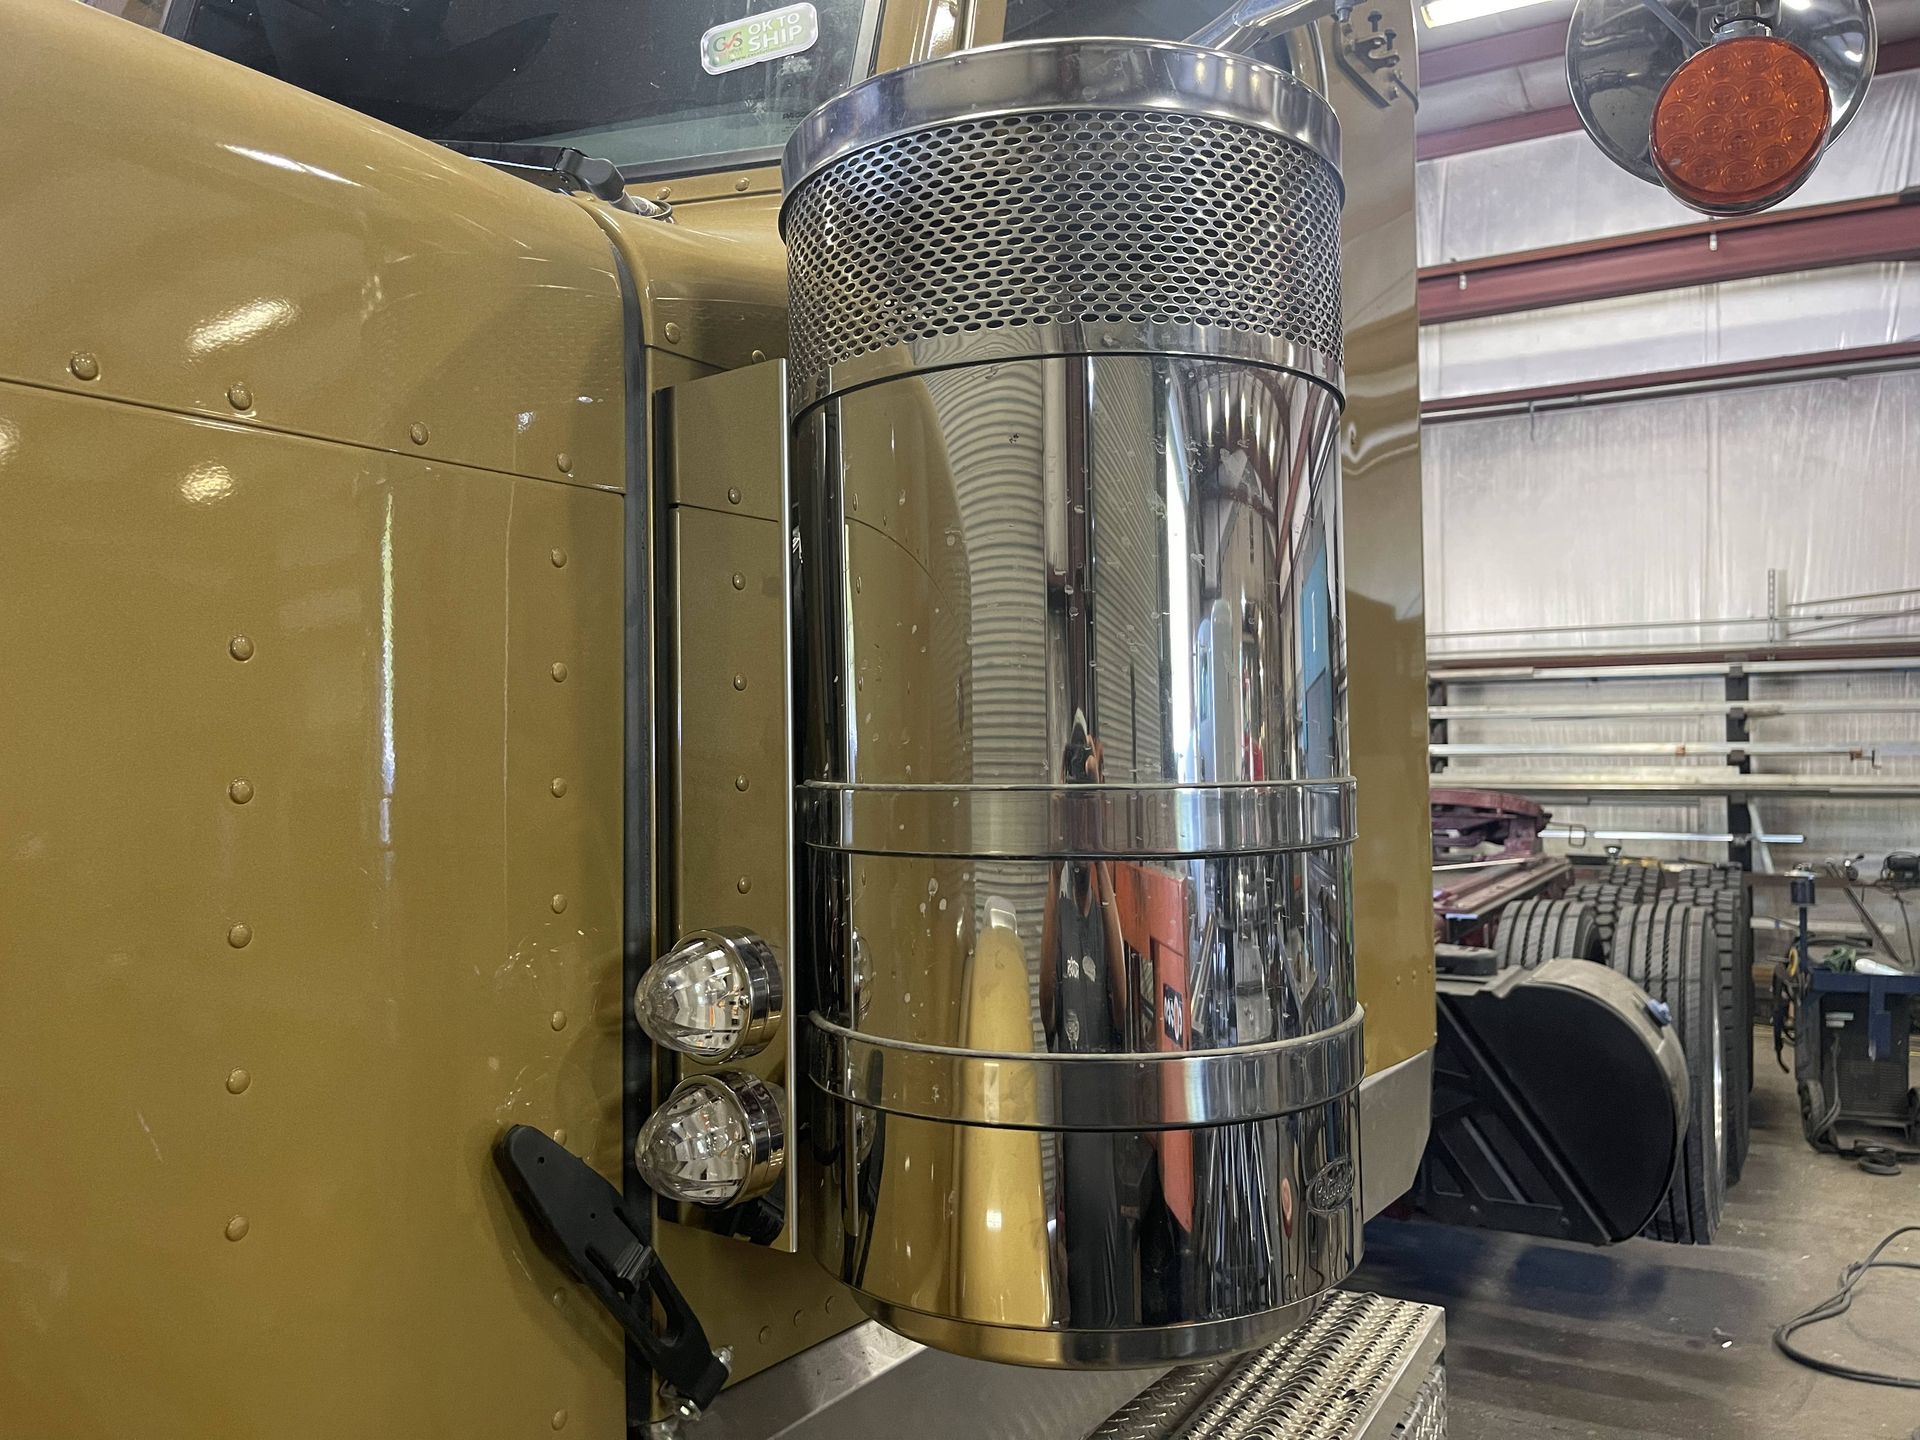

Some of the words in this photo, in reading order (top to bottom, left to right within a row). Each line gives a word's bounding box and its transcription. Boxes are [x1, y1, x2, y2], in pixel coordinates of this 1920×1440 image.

[748, 20, 772, 35] OK
[779, 12, 800, 25] TO
[748, 25, 802, 52] SHIP
